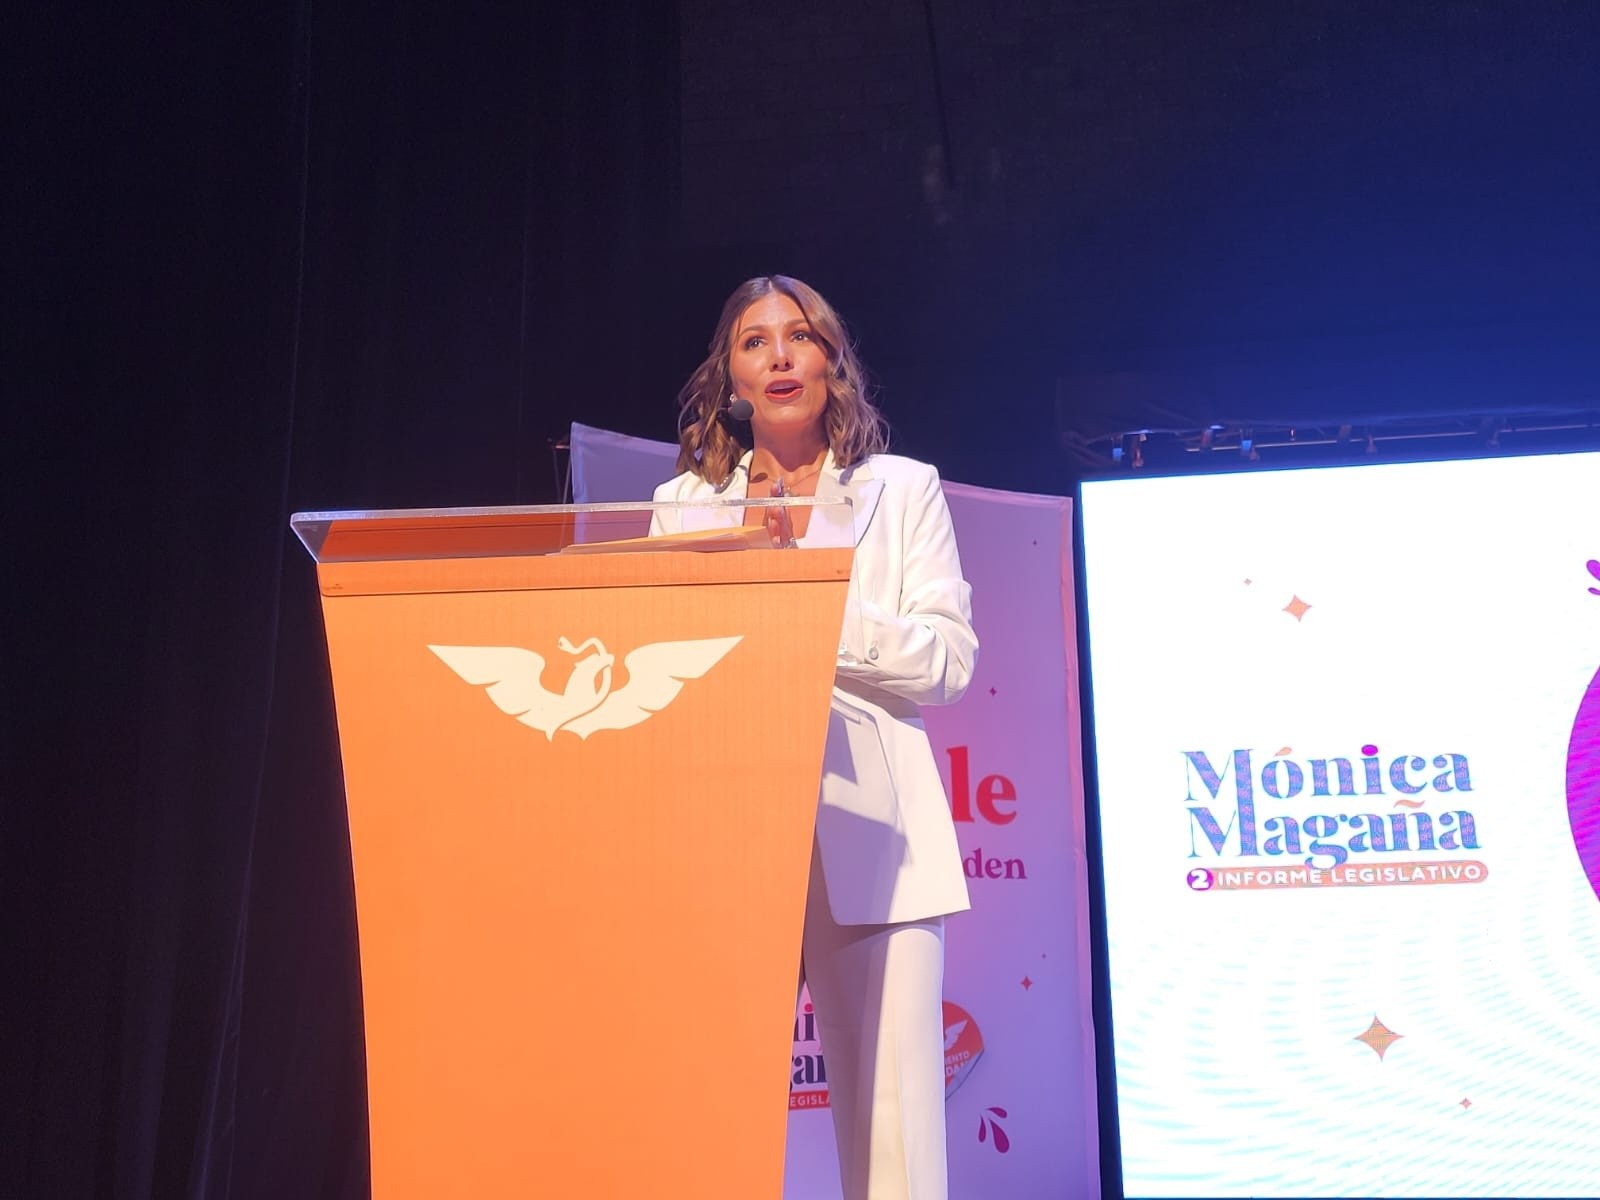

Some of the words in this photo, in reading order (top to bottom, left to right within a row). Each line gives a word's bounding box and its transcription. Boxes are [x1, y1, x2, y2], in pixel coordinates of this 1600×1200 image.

[1181, 744, 1475, 801] Mónica
[1186, 800, 1482, 870] Magaña
[962, 848, 1028, 880] den
[1190, 869, 1209, 890] 2
[1217, 869, 1321, 886] INFORME
[1331, 864, 1482, 884] LEGISLATIVO
